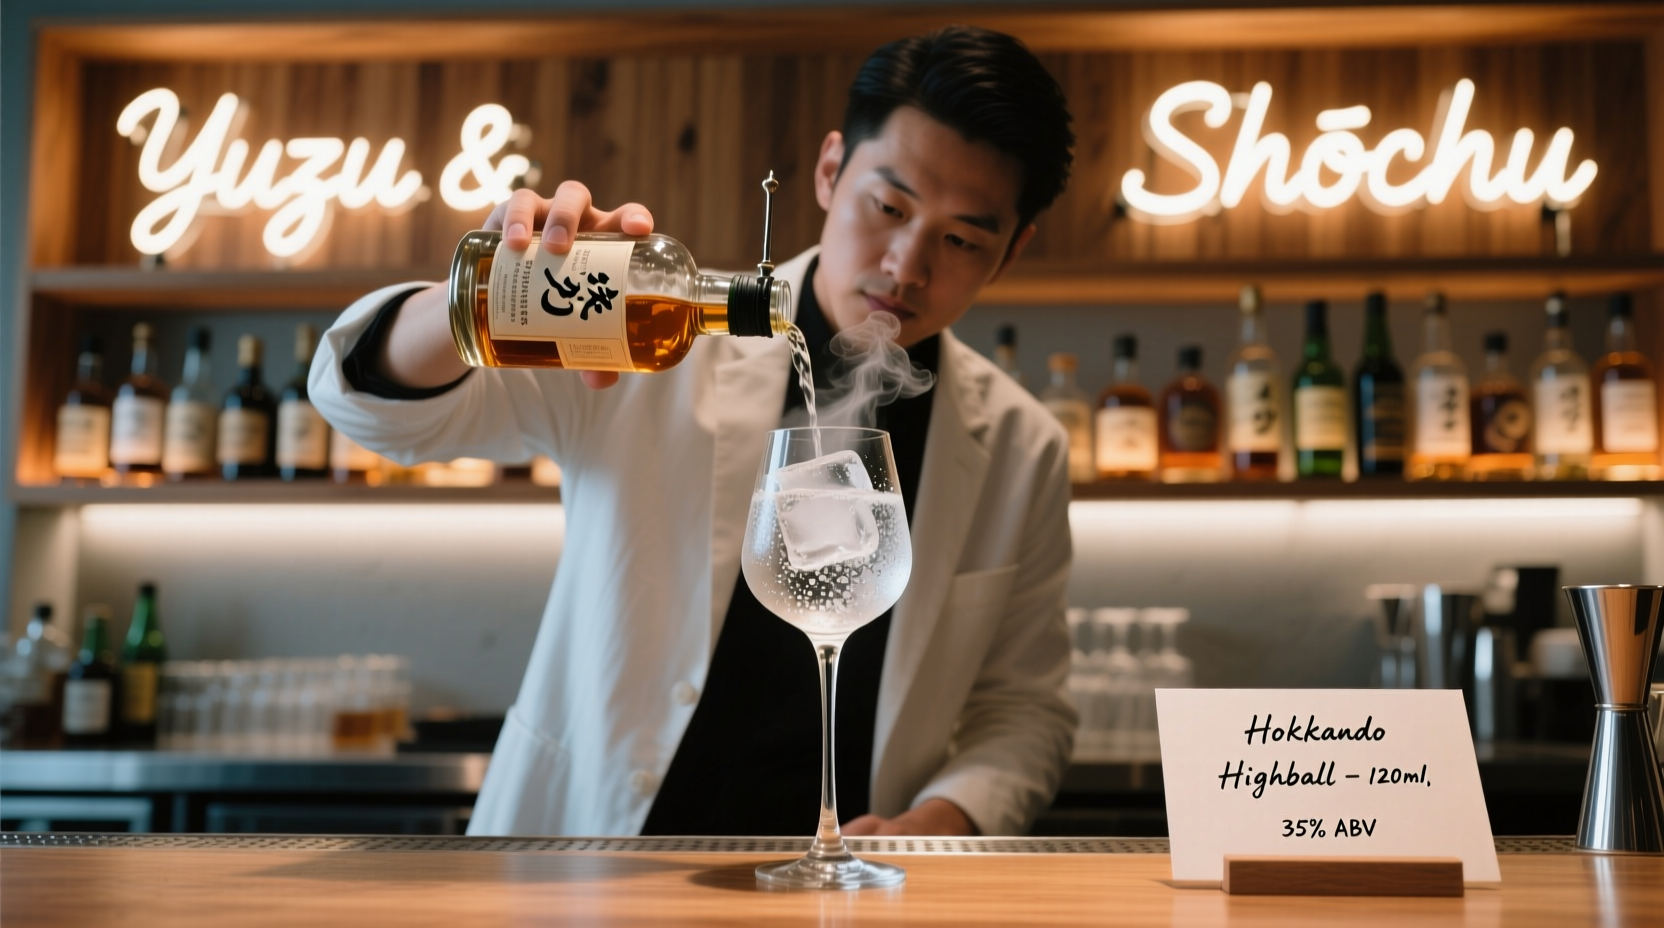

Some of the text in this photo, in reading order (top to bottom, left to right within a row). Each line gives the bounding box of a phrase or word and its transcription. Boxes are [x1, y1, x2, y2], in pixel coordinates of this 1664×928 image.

[1121, 78, 1598, 217] Shōchu
[117, 88, 530, 257] Yuzu &
[1244, 713, 1386, 746] Hokkando
[1218, 759, 1336, 799] Highball
[1281, 818, 1377, 839] 35% ABV
